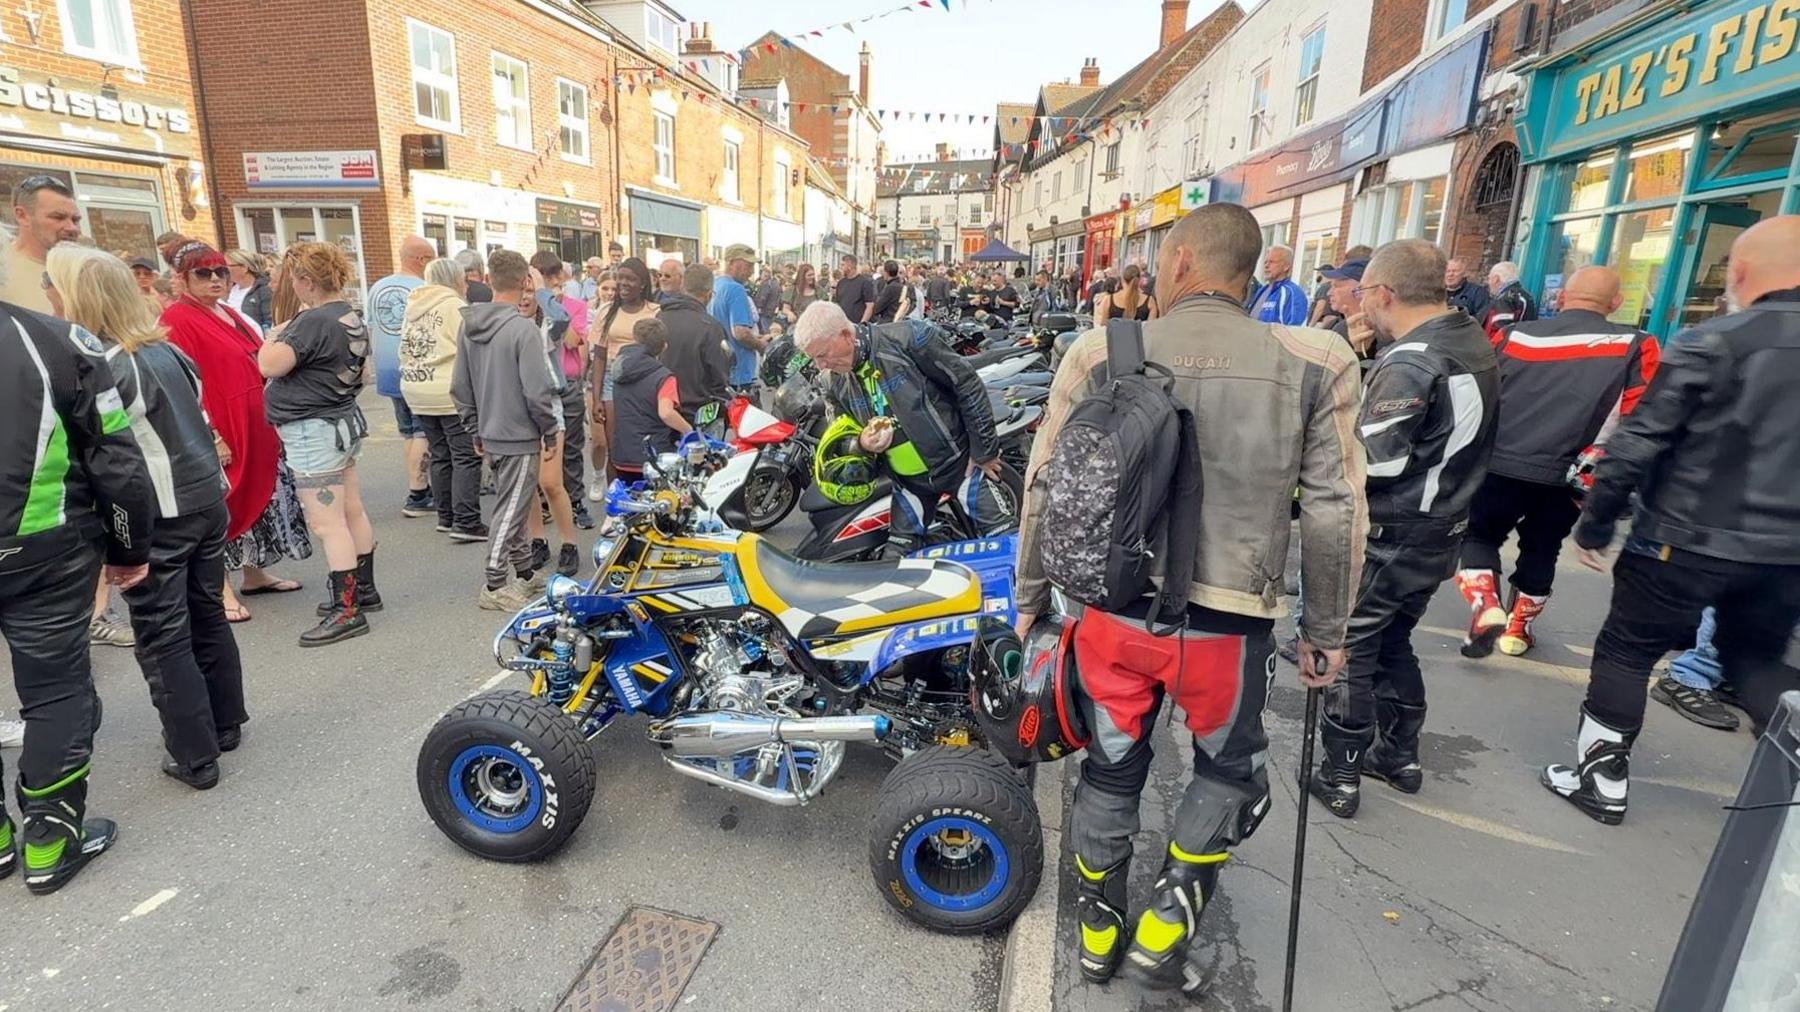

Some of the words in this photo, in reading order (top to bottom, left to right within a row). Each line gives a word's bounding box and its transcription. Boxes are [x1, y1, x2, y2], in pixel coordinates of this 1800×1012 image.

[1575, 31, 1697, 126] TAZ'S
[1697, 0, 1800, 86] FIS
[0, 66, 190, 133] Scissors
[1173, 354, 1232, 370] DUCATI
[112, 502, 132, 550] RST
[612, 662, 643, 708] YAMAHA
[510, 740, 558, 830] MAXXIS
[888, 813, 925, 860] MAXXIS
[932, 807, 993, 825] SPEARZ
